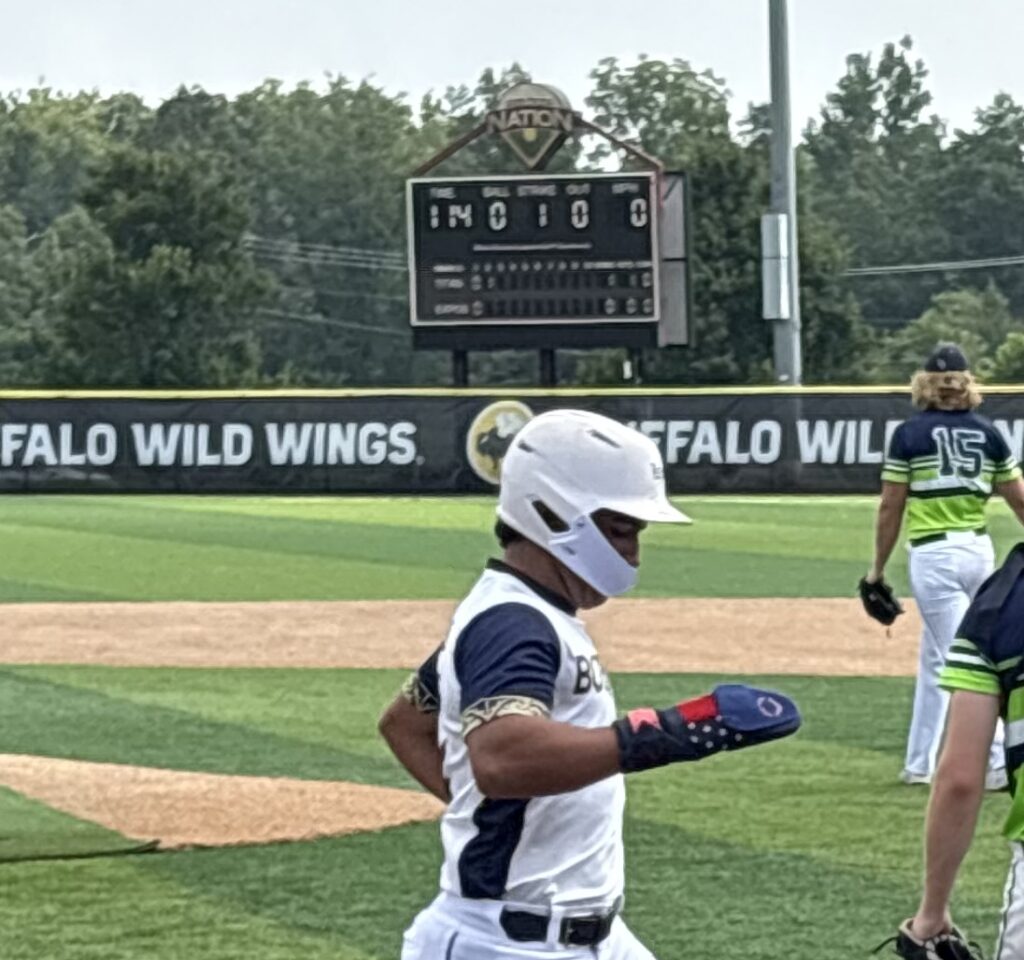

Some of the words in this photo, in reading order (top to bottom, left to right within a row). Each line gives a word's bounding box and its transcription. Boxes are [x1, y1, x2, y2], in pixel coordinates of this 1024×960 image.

[487, 108, 573, 133] NATION
[489, 201, 507, 231] 0
[538, 203, 548, 228] 1
[571, 200, 590, 229] 0
[630, 198, 648, 227] 0
[131, 422, 254, 466] WILD
[264, 421, 418, 465] WINGS
[932, 427, 986, 478] 15
